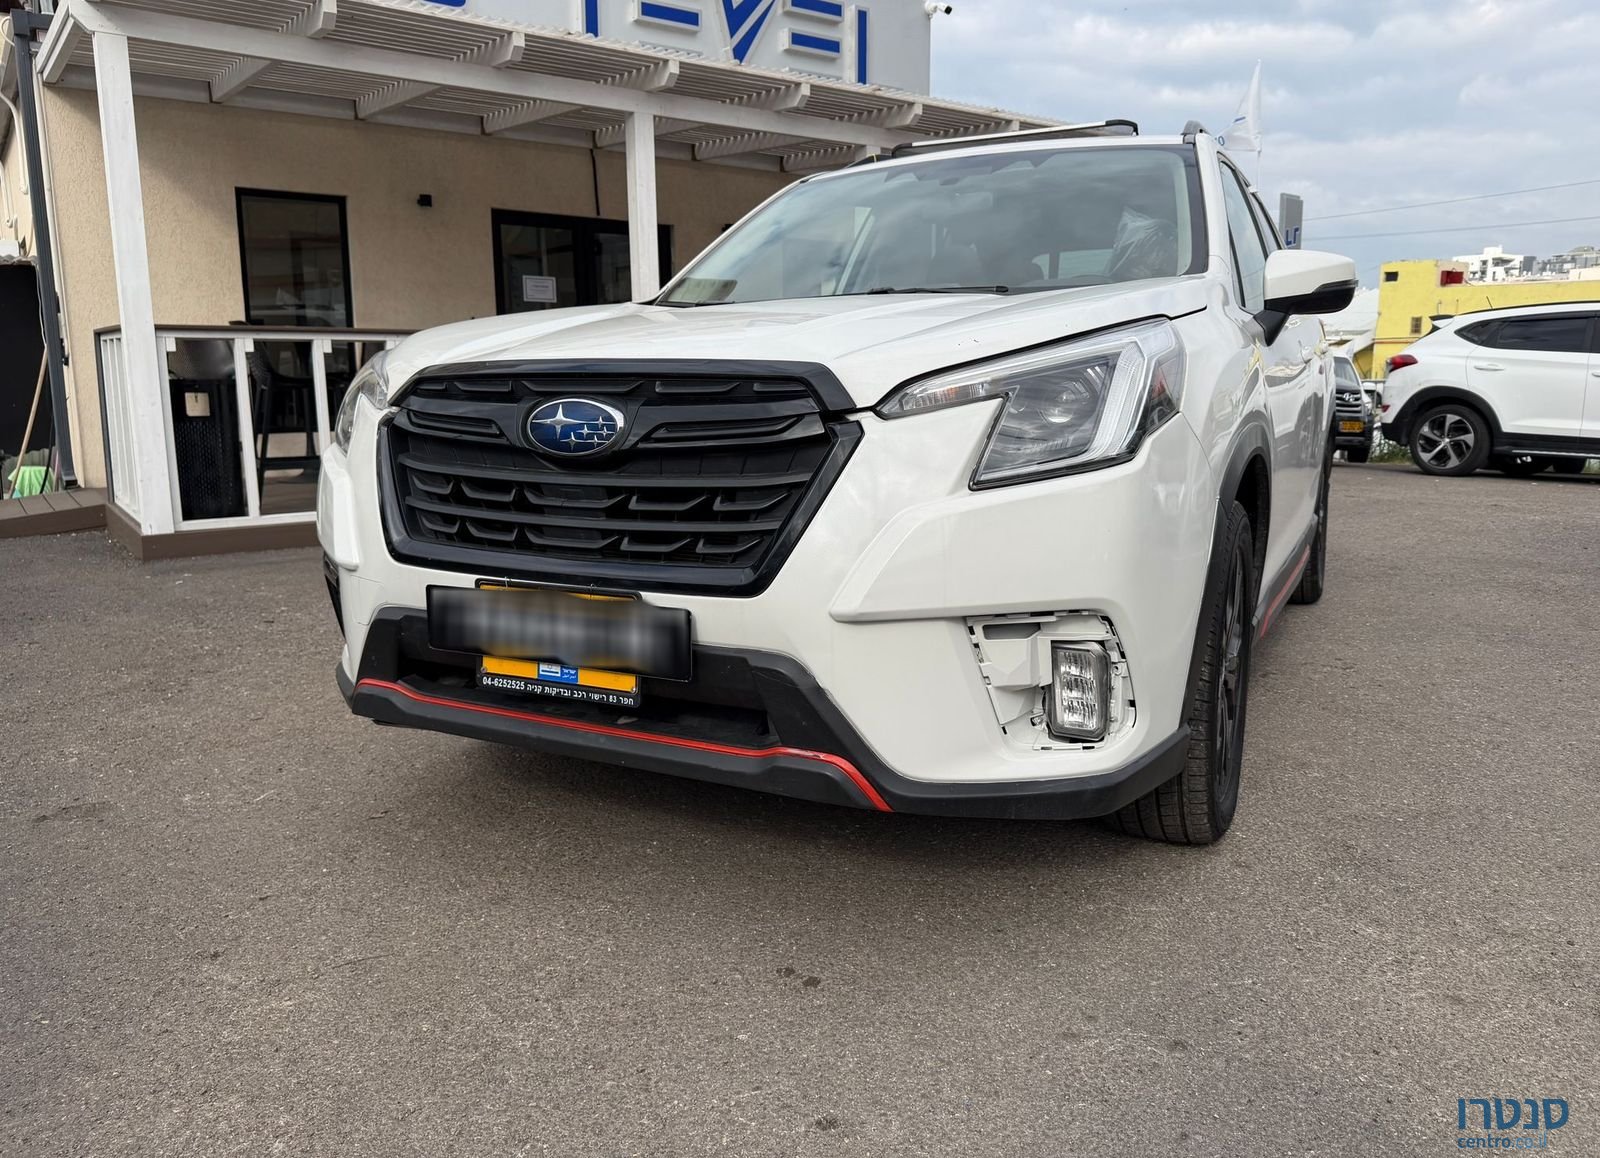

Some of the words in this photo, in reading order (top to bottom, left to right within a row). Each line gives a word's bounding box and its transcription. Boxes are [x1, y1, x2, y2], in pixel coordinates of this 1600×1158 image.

[583, 0, 868, 85] VEL
[482, 676, 525, 690] 04-6252525
[526, 683, 542, 694] קניה
[544, 686, 571, 697] ובדיקות
[573, 690, 587, 699] רכב
[588, 692, 607, 702] רישוי
[619, 696, 634, 706] חפר
